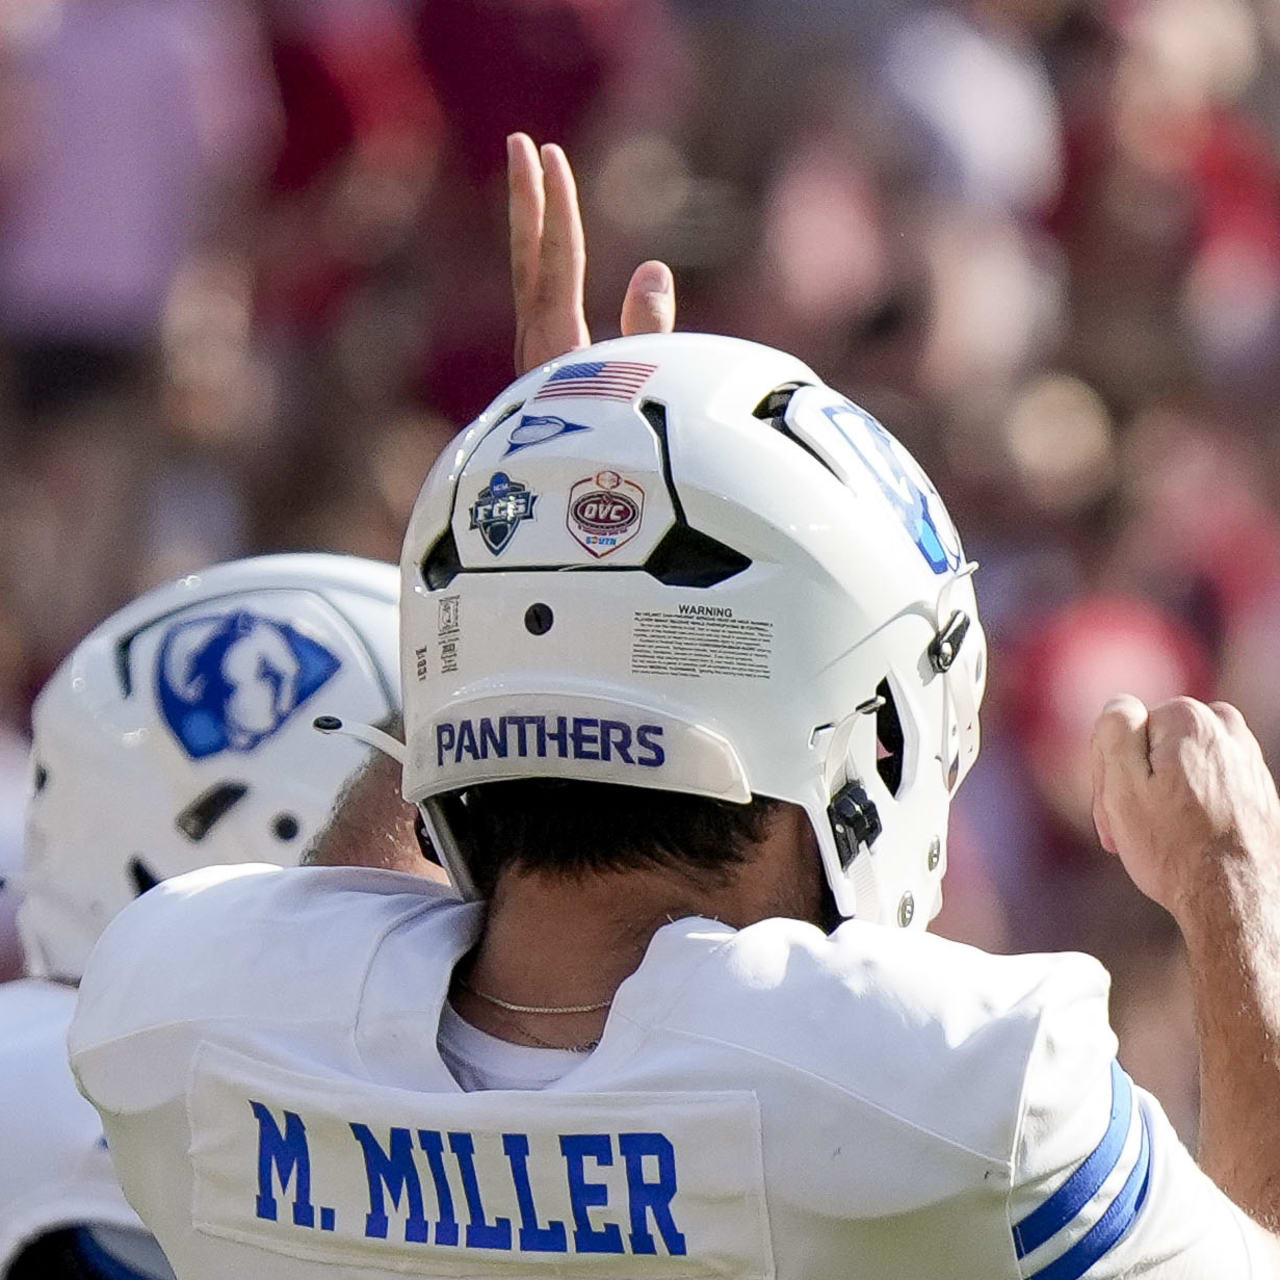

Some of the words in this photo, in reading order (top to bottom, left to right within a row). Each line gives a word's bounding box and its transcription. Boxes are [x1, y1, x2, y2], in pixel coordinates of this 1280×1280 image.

[584, 502, 622, 521] OVC
[678, 604, 733, 617] WARNING
[436, 715, 666, 768] PANTHERS
[249, 1100, 336, 1231] M.
[348, 1121, 687, 1256] MILLER
